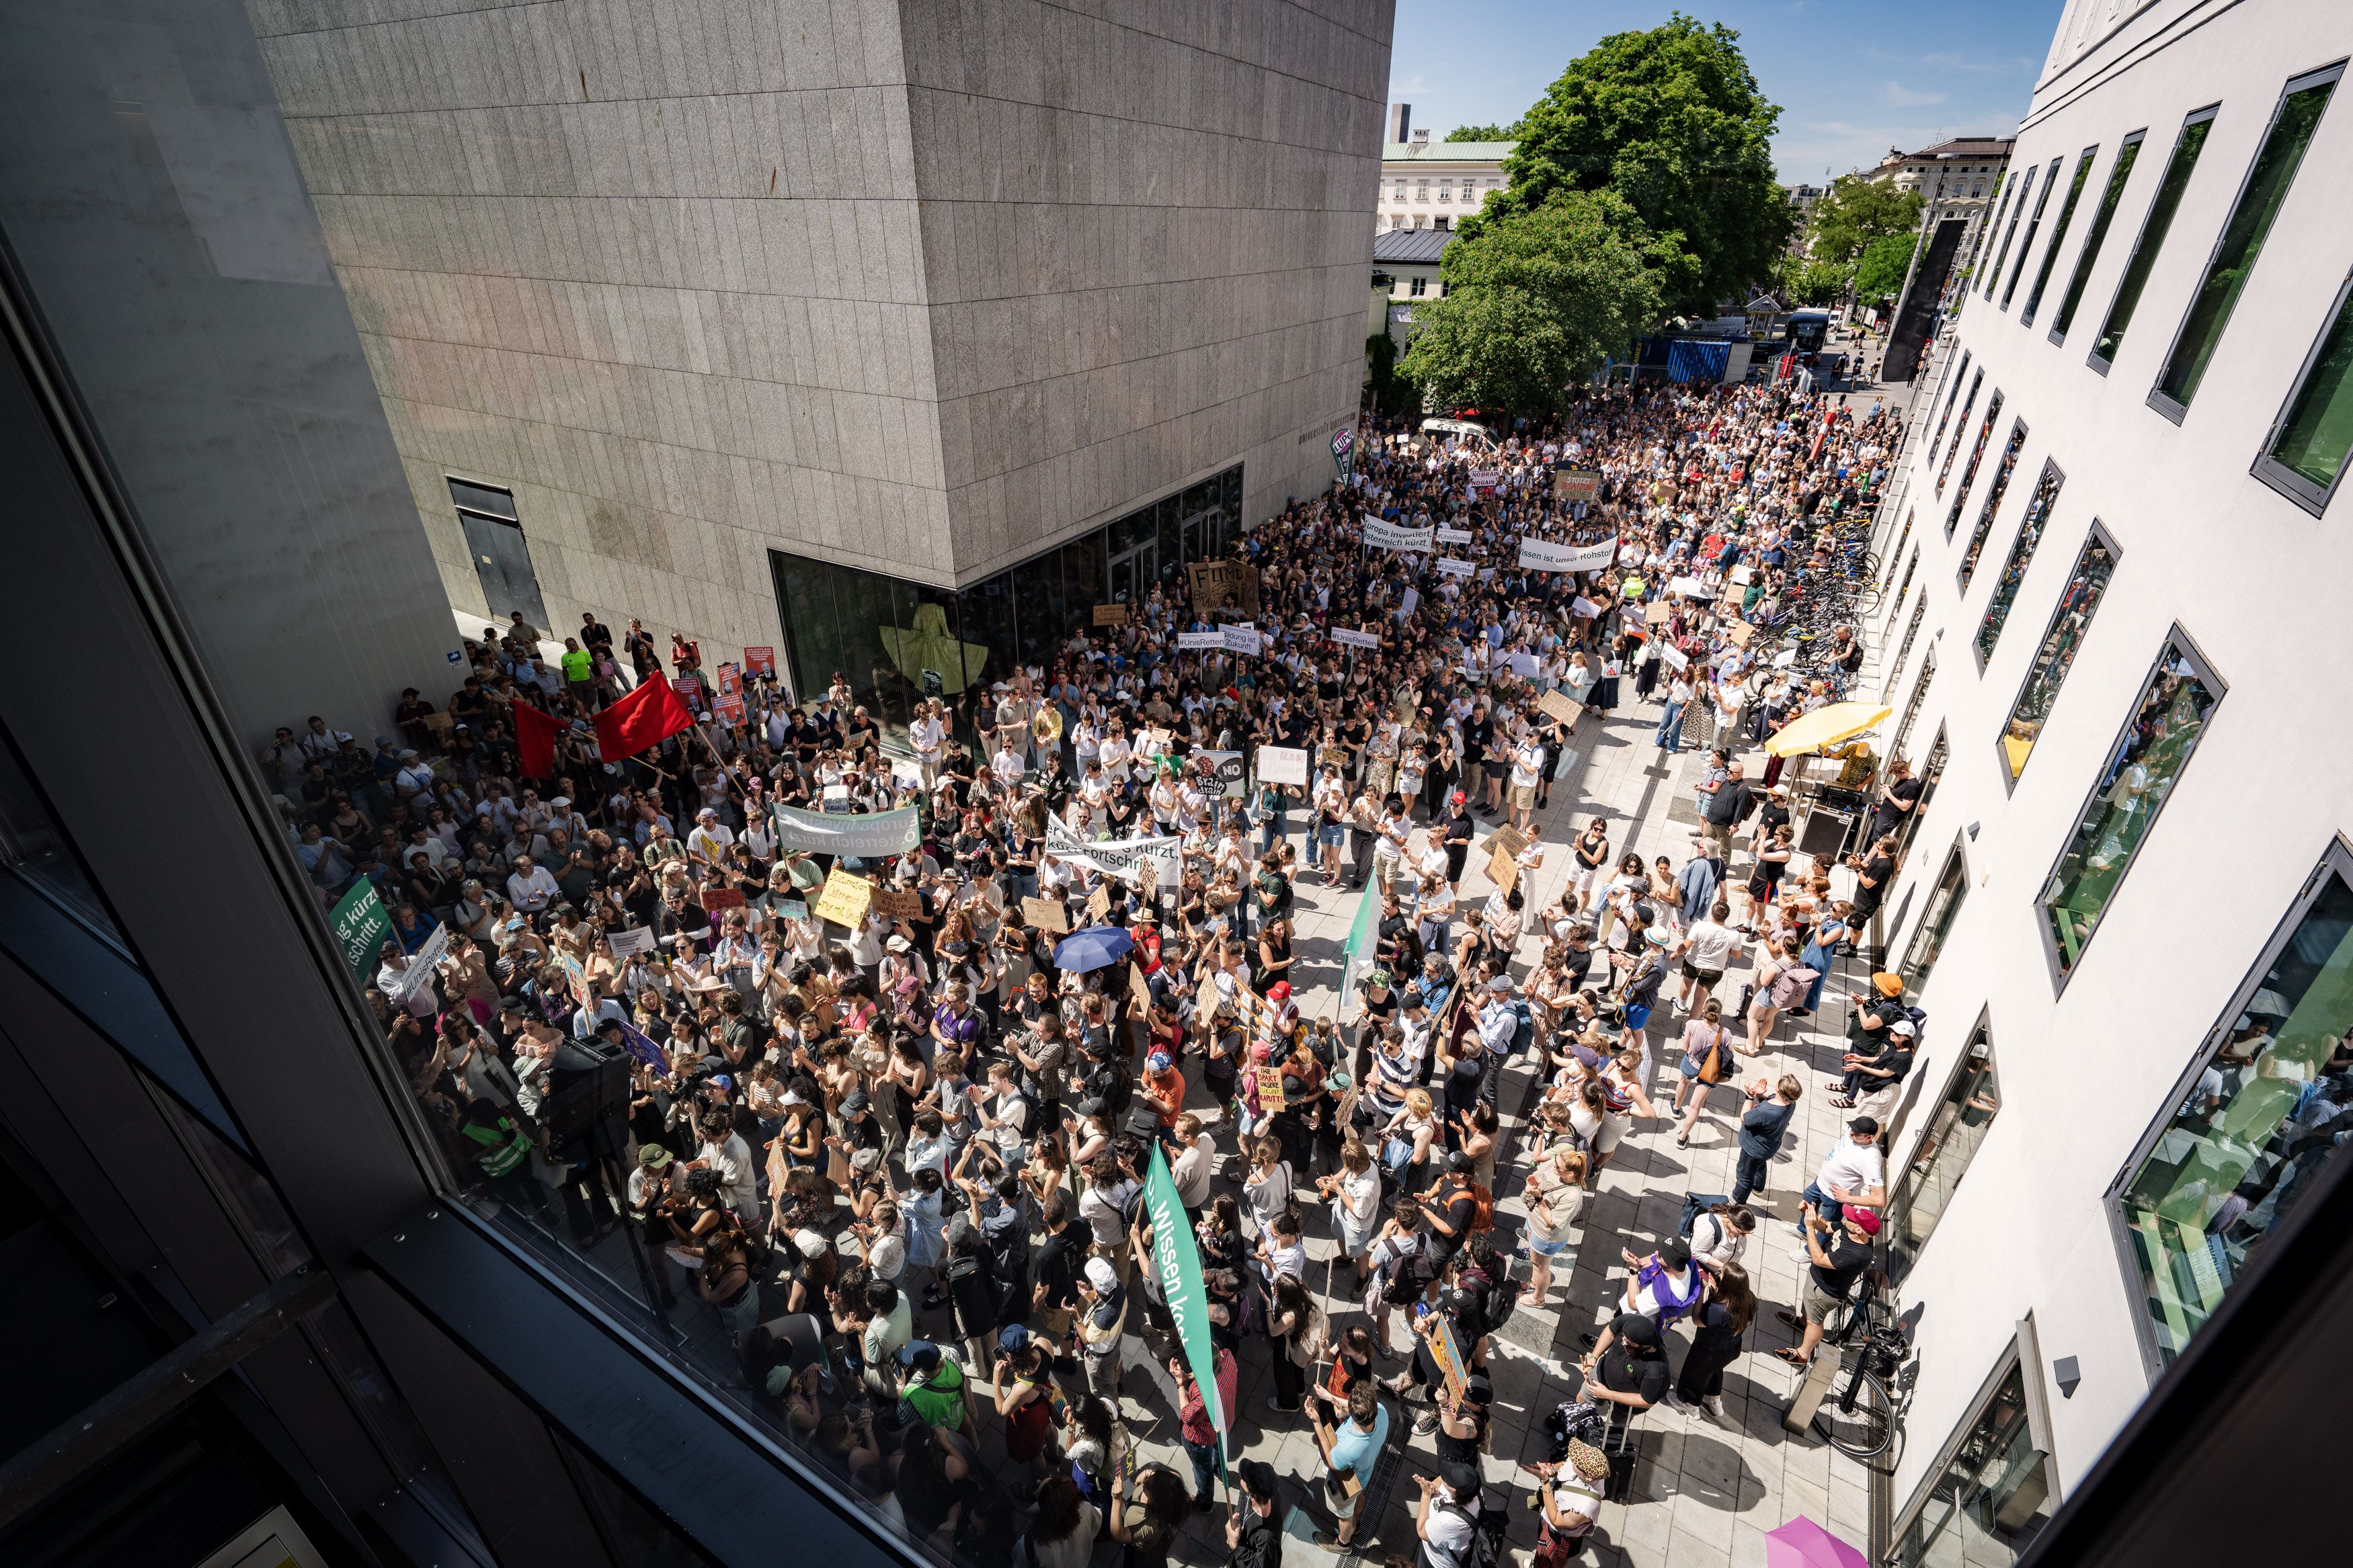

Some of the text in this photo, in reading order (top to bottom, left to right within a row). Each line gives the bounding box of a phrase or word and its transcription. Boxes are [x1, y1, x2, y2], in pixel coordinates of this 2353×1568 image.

[1437, 533, 1471, 542] #UnisRetten
[1544, 554, 1554, 562] ist
[1438, 563, 1474, 574] #UnisRetten
[1193, 590, 1218, 608] BRAIN
[1224, 631, 1246, 643] Bildung
[1332, 633, 1377, 647] #UnisRetten
[1226, 639, 1251, 650] Zukunft
[1662, 649, 1685, 669] #UnisRetten
[1280, 751, 1305, 763] BILDUNG
[1223, 765, 1240, 776] NO
[1195, 776, 1225, 791] Brain
[1198, 786, 1221, 795] drain
[1083, 848, 1159, 874] Fortschri.
[1499, 860, 1512, 880] FUTURE
[1100, 886, 1109, 910] EDUCATION
[346, 886, 379, 926] kürzt
[834, 905, 845, 916] mit
[1090, 894, 1100, 919] FUTURE
[406, 935, 448, 997] #UnisRetten
[1260, 1095, 1283, 1103] KAPUTT!
[1153, 1199, 1182, 1294] Wissen
